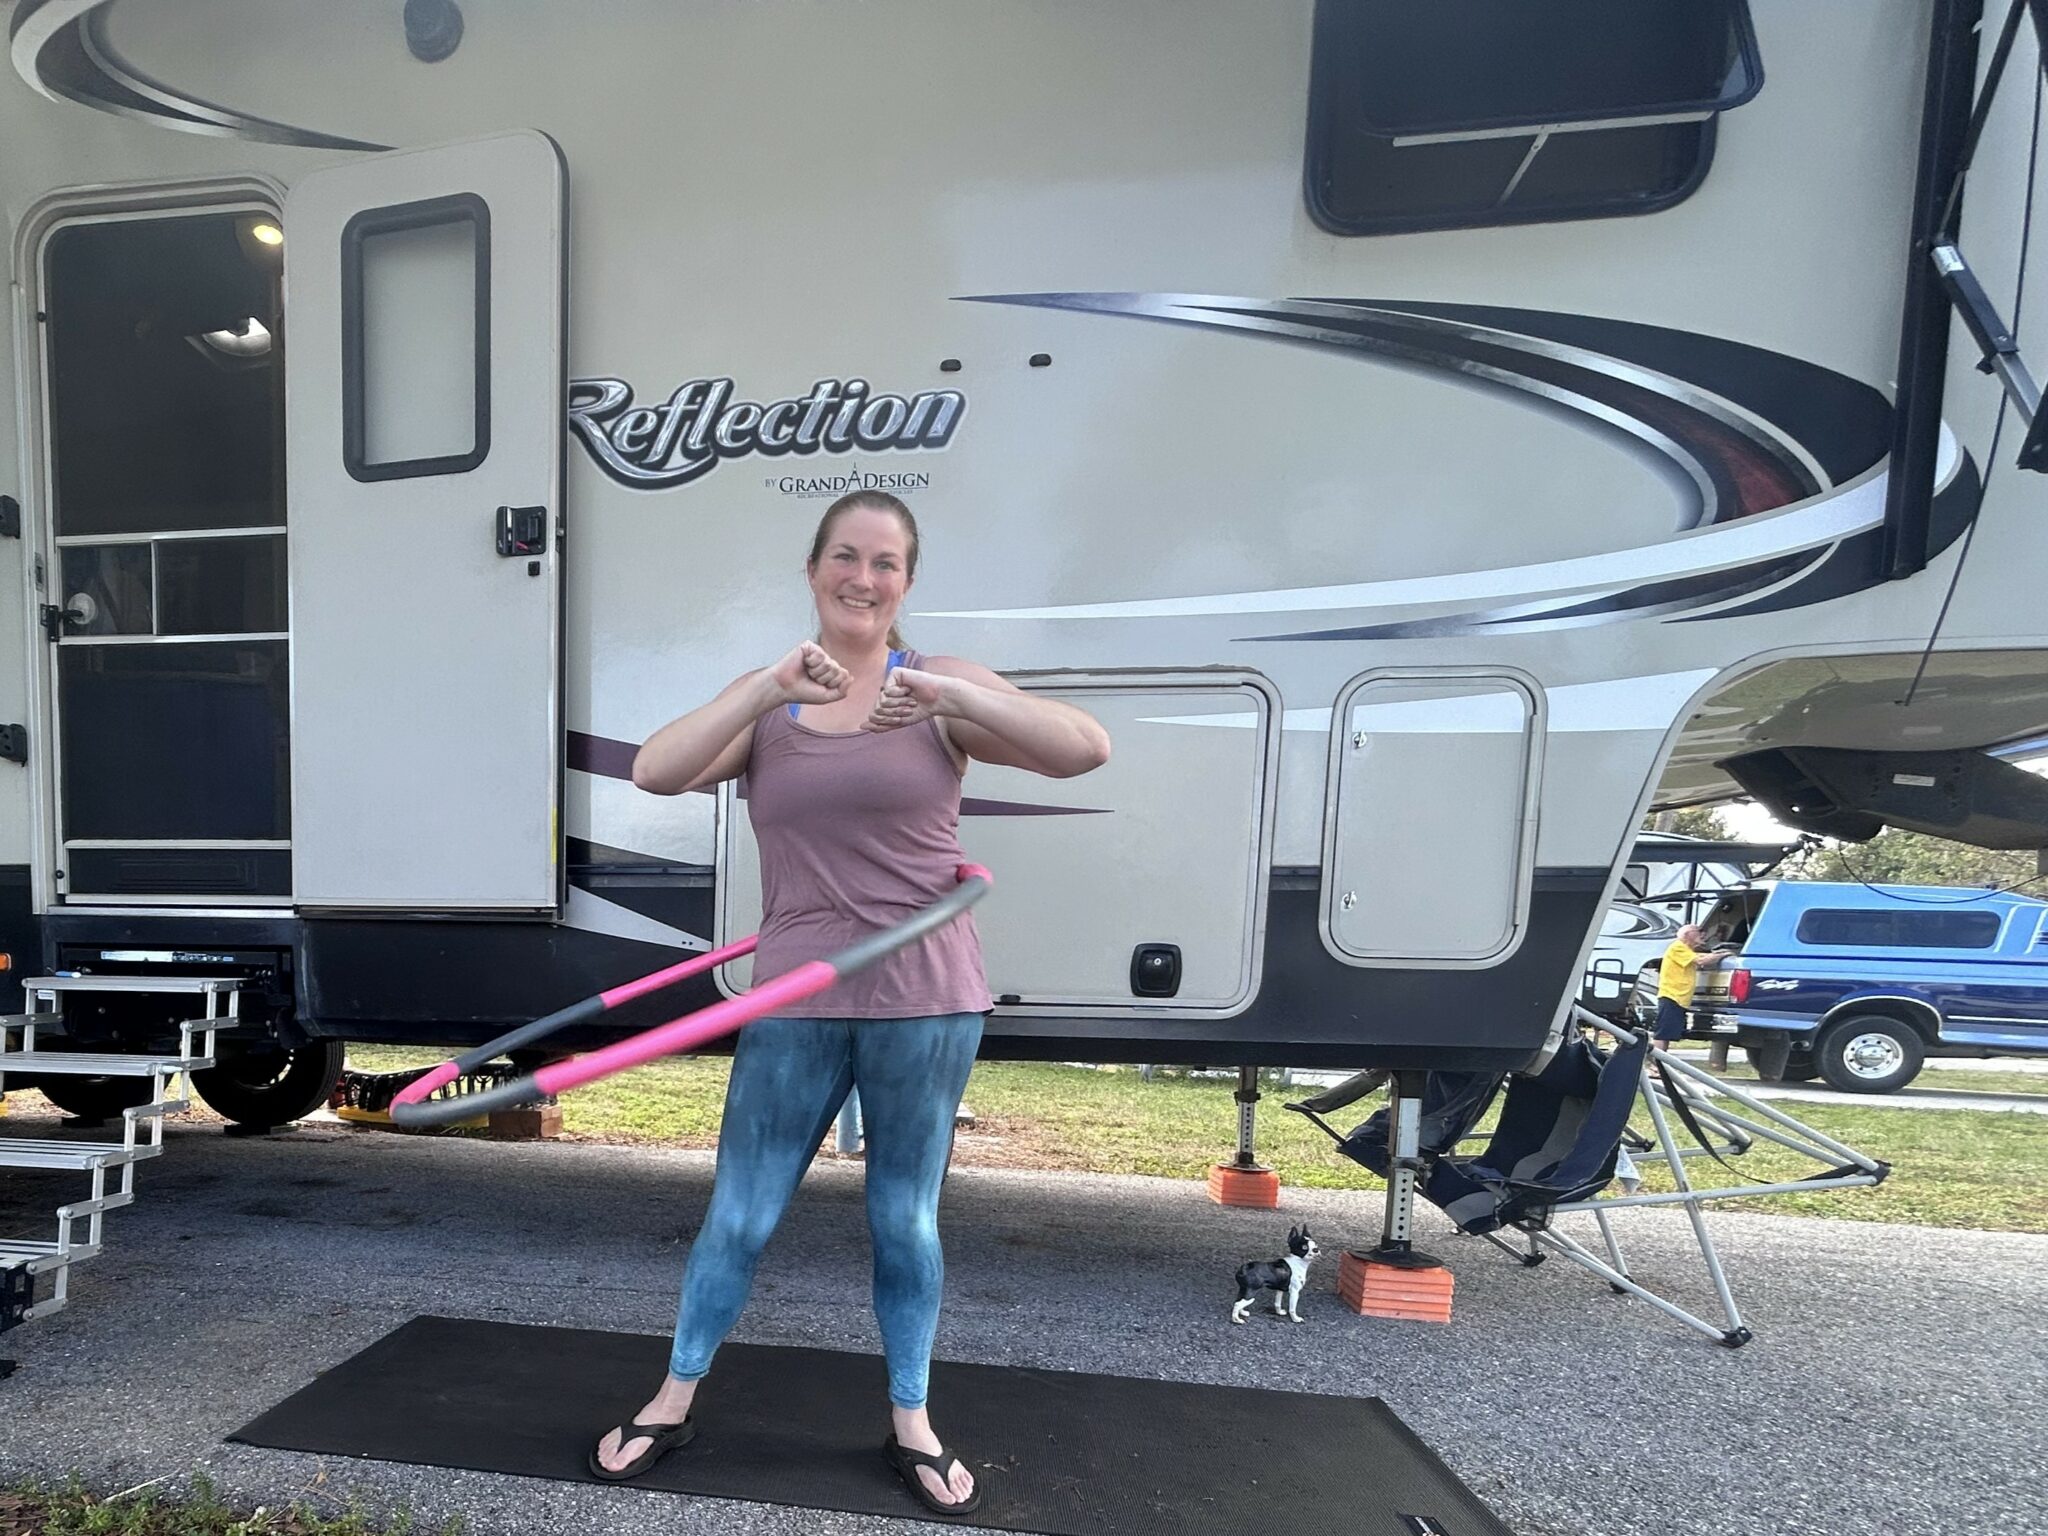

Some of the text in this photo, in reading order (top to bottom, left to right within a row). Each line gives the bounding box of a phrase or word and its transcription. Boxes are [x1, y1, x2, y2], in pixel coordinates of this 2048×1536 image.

[569, 376, 967, 492] Reflection
[765, 472, 930, 493] BY GRAND DESIGN
